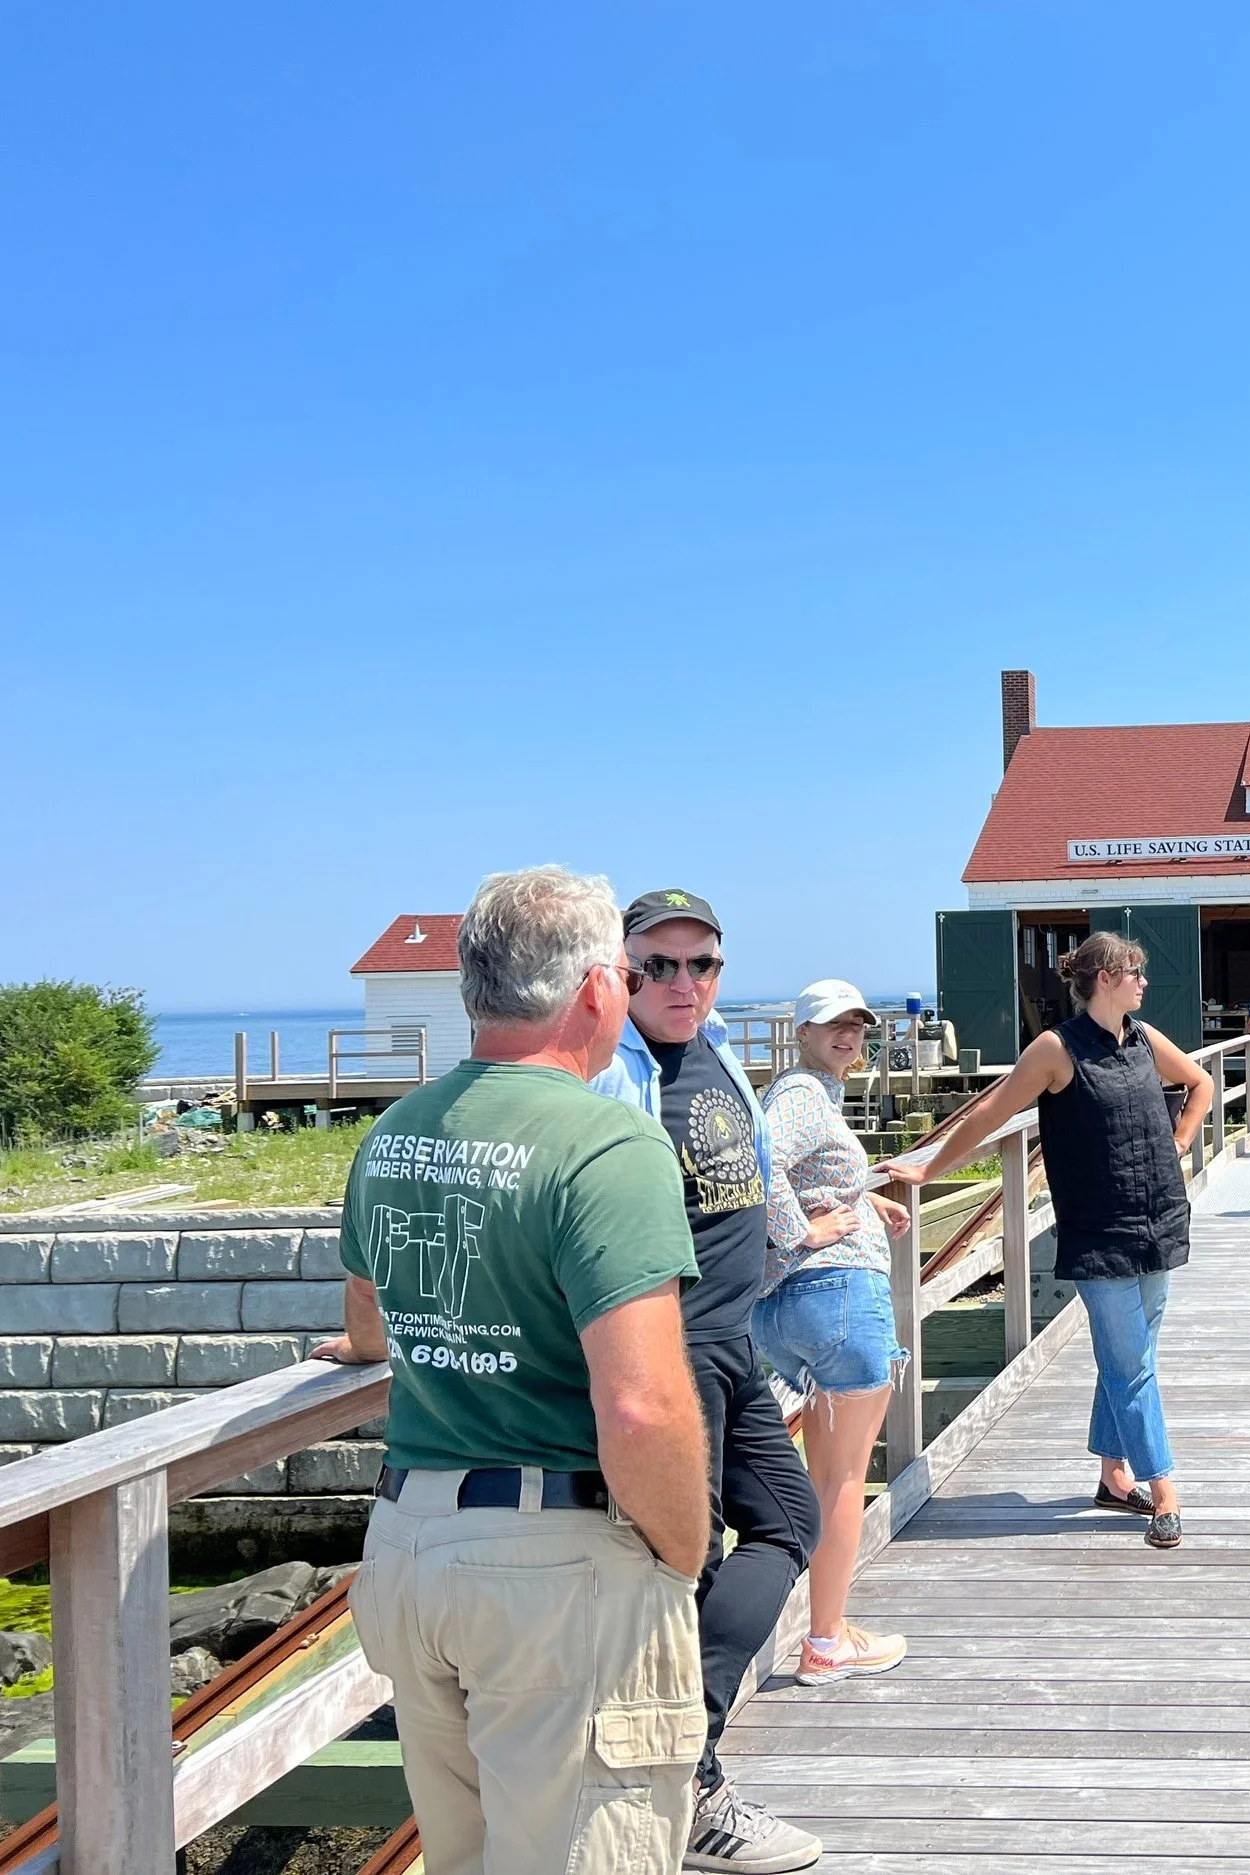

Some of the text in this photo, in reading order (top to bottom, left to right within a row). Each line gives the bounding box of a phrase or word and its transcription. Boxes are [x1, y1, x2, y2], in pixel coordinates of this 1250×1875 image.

[1074, 844, 1100, 857] U.S.
[1106, 843, 1143, 856] LIFE
[1148, 840, 1208, 854] SAVING
[368, 1134, 536, 1168] PRESERVATION
[365, 1160, 411, 1180] TIMBER
[487, 1169, 520, 1189] INC.
[809, 1655, 834, 1667] HOKA
